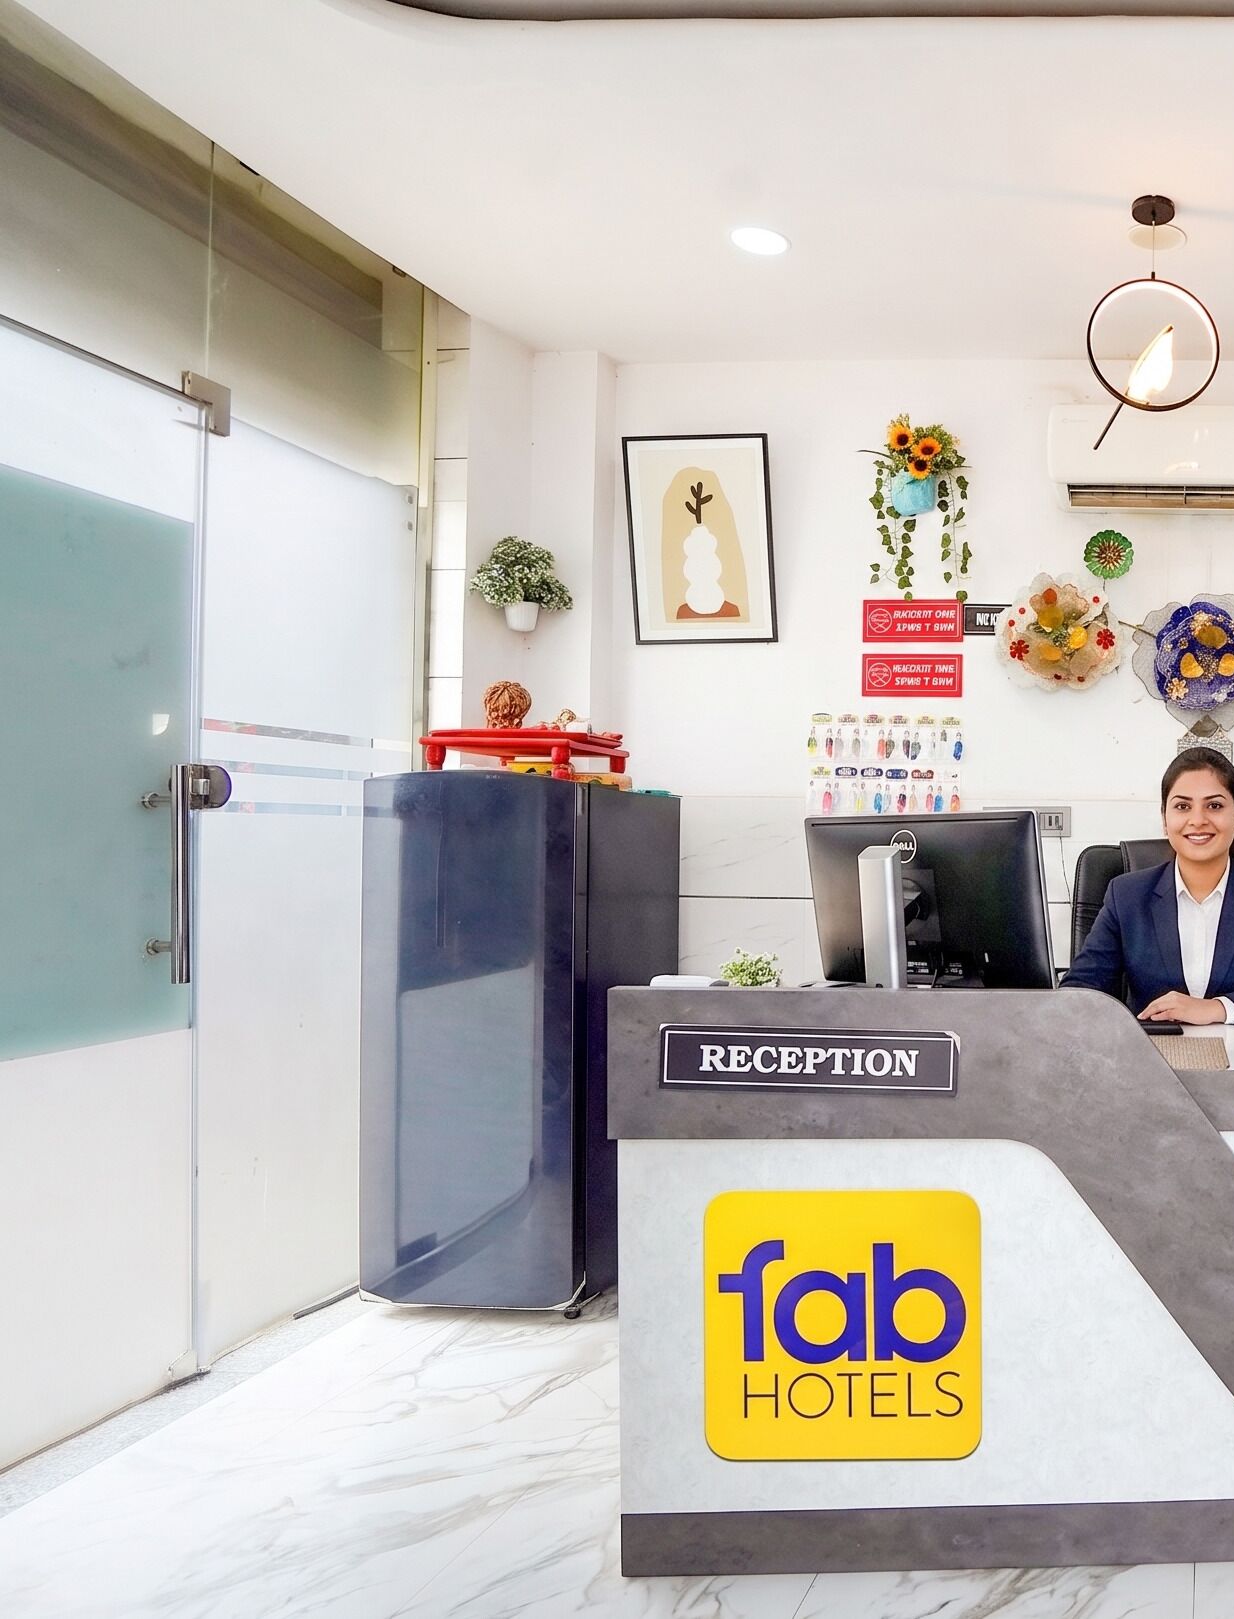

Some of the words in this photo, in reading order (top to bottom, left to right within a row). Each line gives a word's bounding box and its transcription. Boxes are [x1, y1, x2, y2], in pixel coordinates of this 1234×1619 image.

[699, 1044, 920, 1077] RECEPTION
[718, 1239, 966, 1364] fab
[744, 1371, 963, 1419] HOTELS
